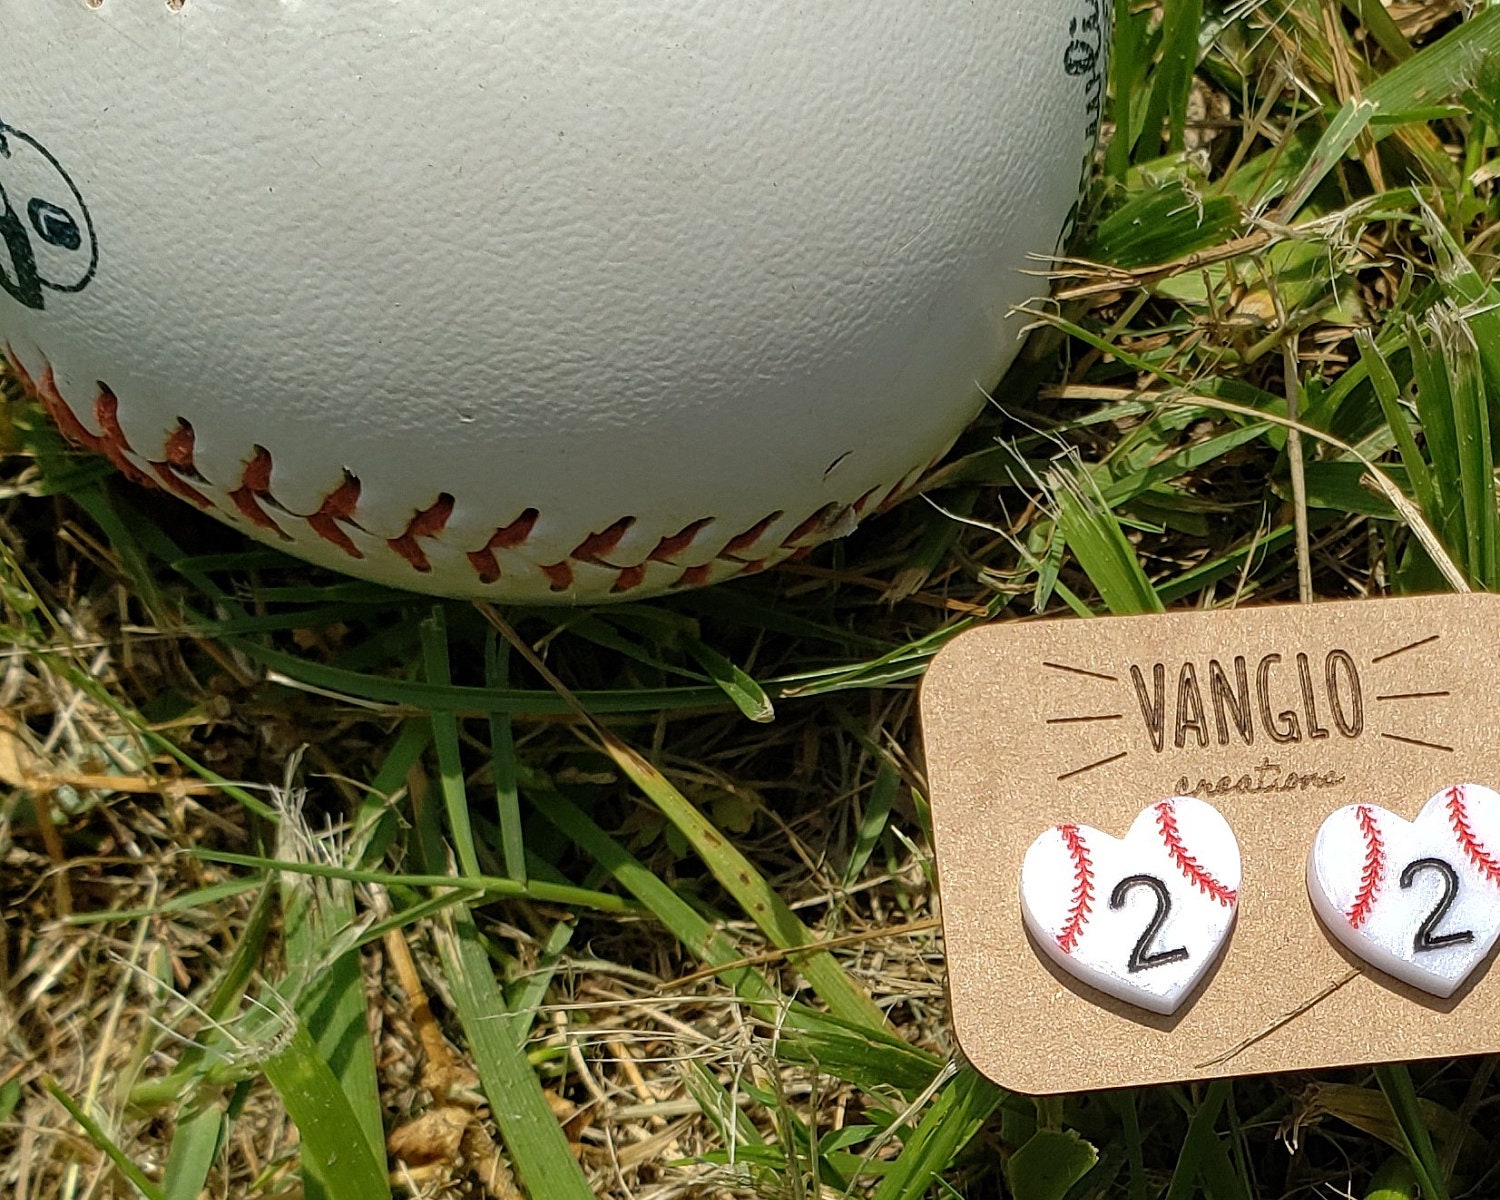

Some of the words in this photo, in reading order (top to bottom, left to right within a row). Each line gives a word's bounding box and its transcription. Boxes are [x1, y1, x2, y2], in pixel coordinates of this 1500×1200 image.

[1129, 648, 1365, 754] VANGLO
[1173, 757, 1347, 797] creations
[1109, 873, 1190, 975] 2
[1399, 856, 1477, 954] 2
